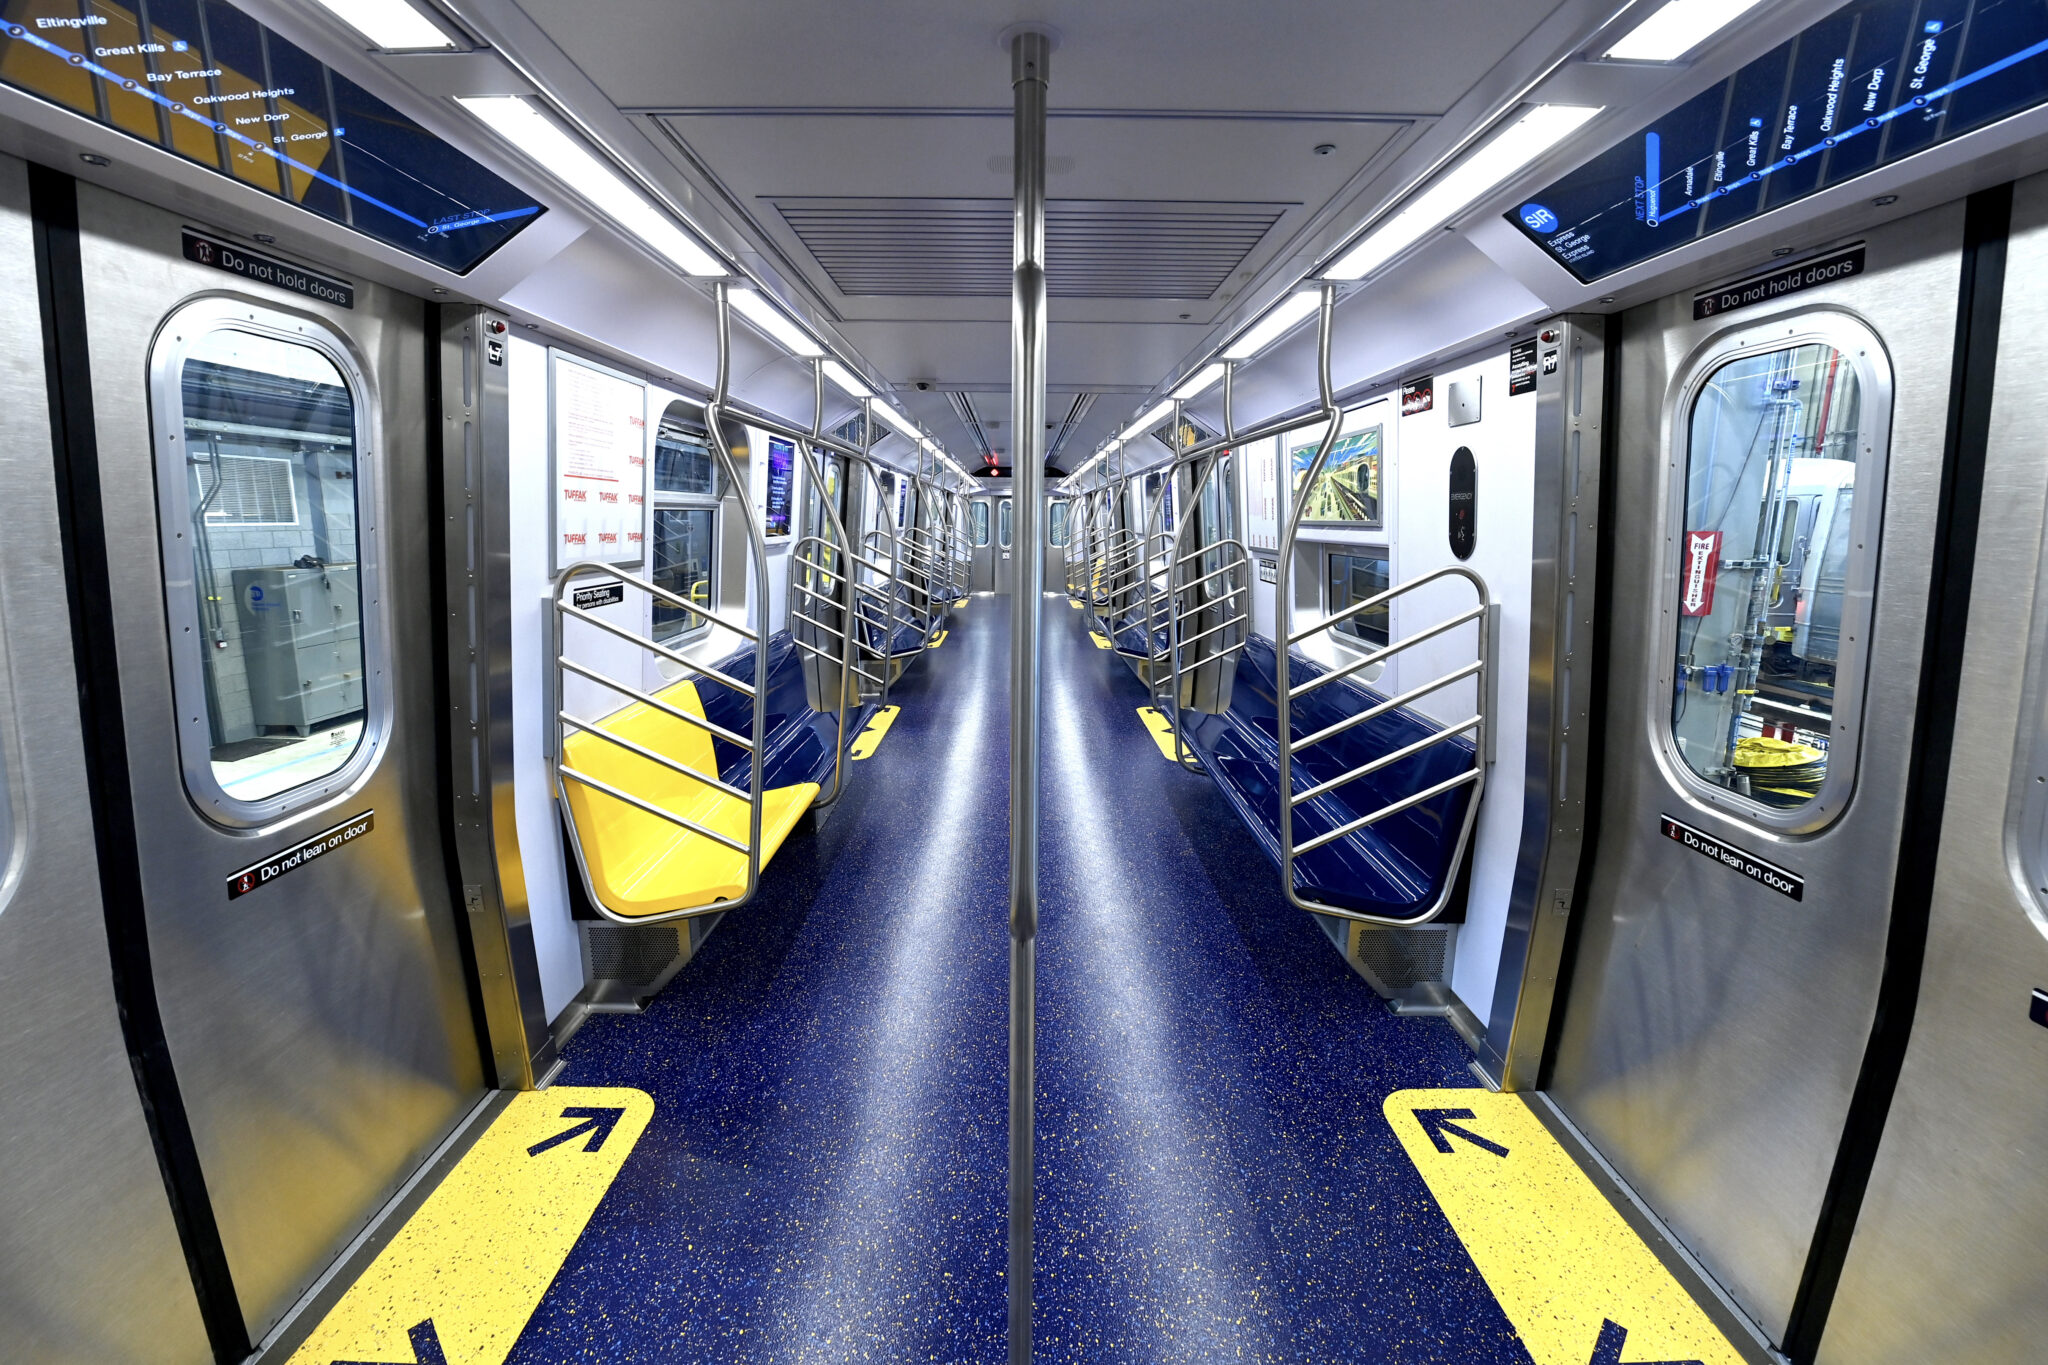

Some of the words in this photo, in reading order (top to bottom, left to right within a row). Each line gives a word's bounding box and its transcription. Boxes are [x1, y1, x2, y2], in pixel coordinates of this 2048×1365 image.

[36, 15, 108, 28] Eltingville
[95, 46, 135, 57] Great
[137, 43, 166, 54] Kills
[1914, 38, 1937, 75] George
[147, 72, 173, 82] Bay
[175, 68, 222, 80] Terrace
[1827, 58, 1845, 92] Heights
[1867, 68, 1885, 91] Dorp
[1910, 76, 1925, 90] St.
[194, 92, 250, 105] Oakwood
[252, 88, 295, 98] Heights
[1863, 92, 1878, 112] New
[235, 116, 260, 126] New
[264, 112, 290, 122] Dorp
[1784, 104, 1798, 134] Terrace
[1820, 93, 1838, 132] Oakwood
[274, 136, 288, 144] St.
[291, 130, 328, 142] George
[1749, 130, 1760, 145] Kills
[1782, 134, 1794, 150] Bay
[1746, 145, 1756, 166] Great
[1714, 150, 1725, 182] Eltingville
[1634, 176, 1645, 198] STOP
[1684, 166, 1694, 197] Annadale
[1635, 200, 1644, 220] NEXT
[1649, 190, 1658, 217] Huguenot
[434, 215, 460, 224] LAST
[462, 208, 491, 220] STOP
[454, 219, 480, 228] George
[1524, 208, 1554, 228] SIR
[1547, 232, 1575, 247] Express
[1564, 234, 1590, 248] George
[1562, 244, 1590, 260] Express
[222, 250, 244, 271] Do
[250, 262, 273, 281] not
[276, 268, 306, 290] hold
[310, 280, 346, 303] doors
[1721, 294, 1740, 308] Do
[1743, 284, 1766, 302] not
[1769, 272, 1800, 295] hold
[1806, 260, 1853, 284] doors
[564, 489, 587, 500] TUFFAK
[599, 492, 618, 502] TUFFAK
[564, 534, 586, 545] TUFFAK
[598, 532, 618, 544] TUFFAK
[1691, 551, 1702, 608] EXTINGUISHER
[576, 593, 593, 601] Priority
[594, 588, 610, 598] Seating
[261, 866, 280, 882] Do
[282, 853, 301, 872] not
[303, 842, 326, 860] lean
[328, 834, 342, 848] on
[344, 822, 368, 840] door
[1684, 832, 1700, 848] Do
[1701, 842, 1718, 858] not
[1720, 848, 1744, 870] lean
[1746, 864, 1761, 878] on
[1764, 872, 1794, 894] door
